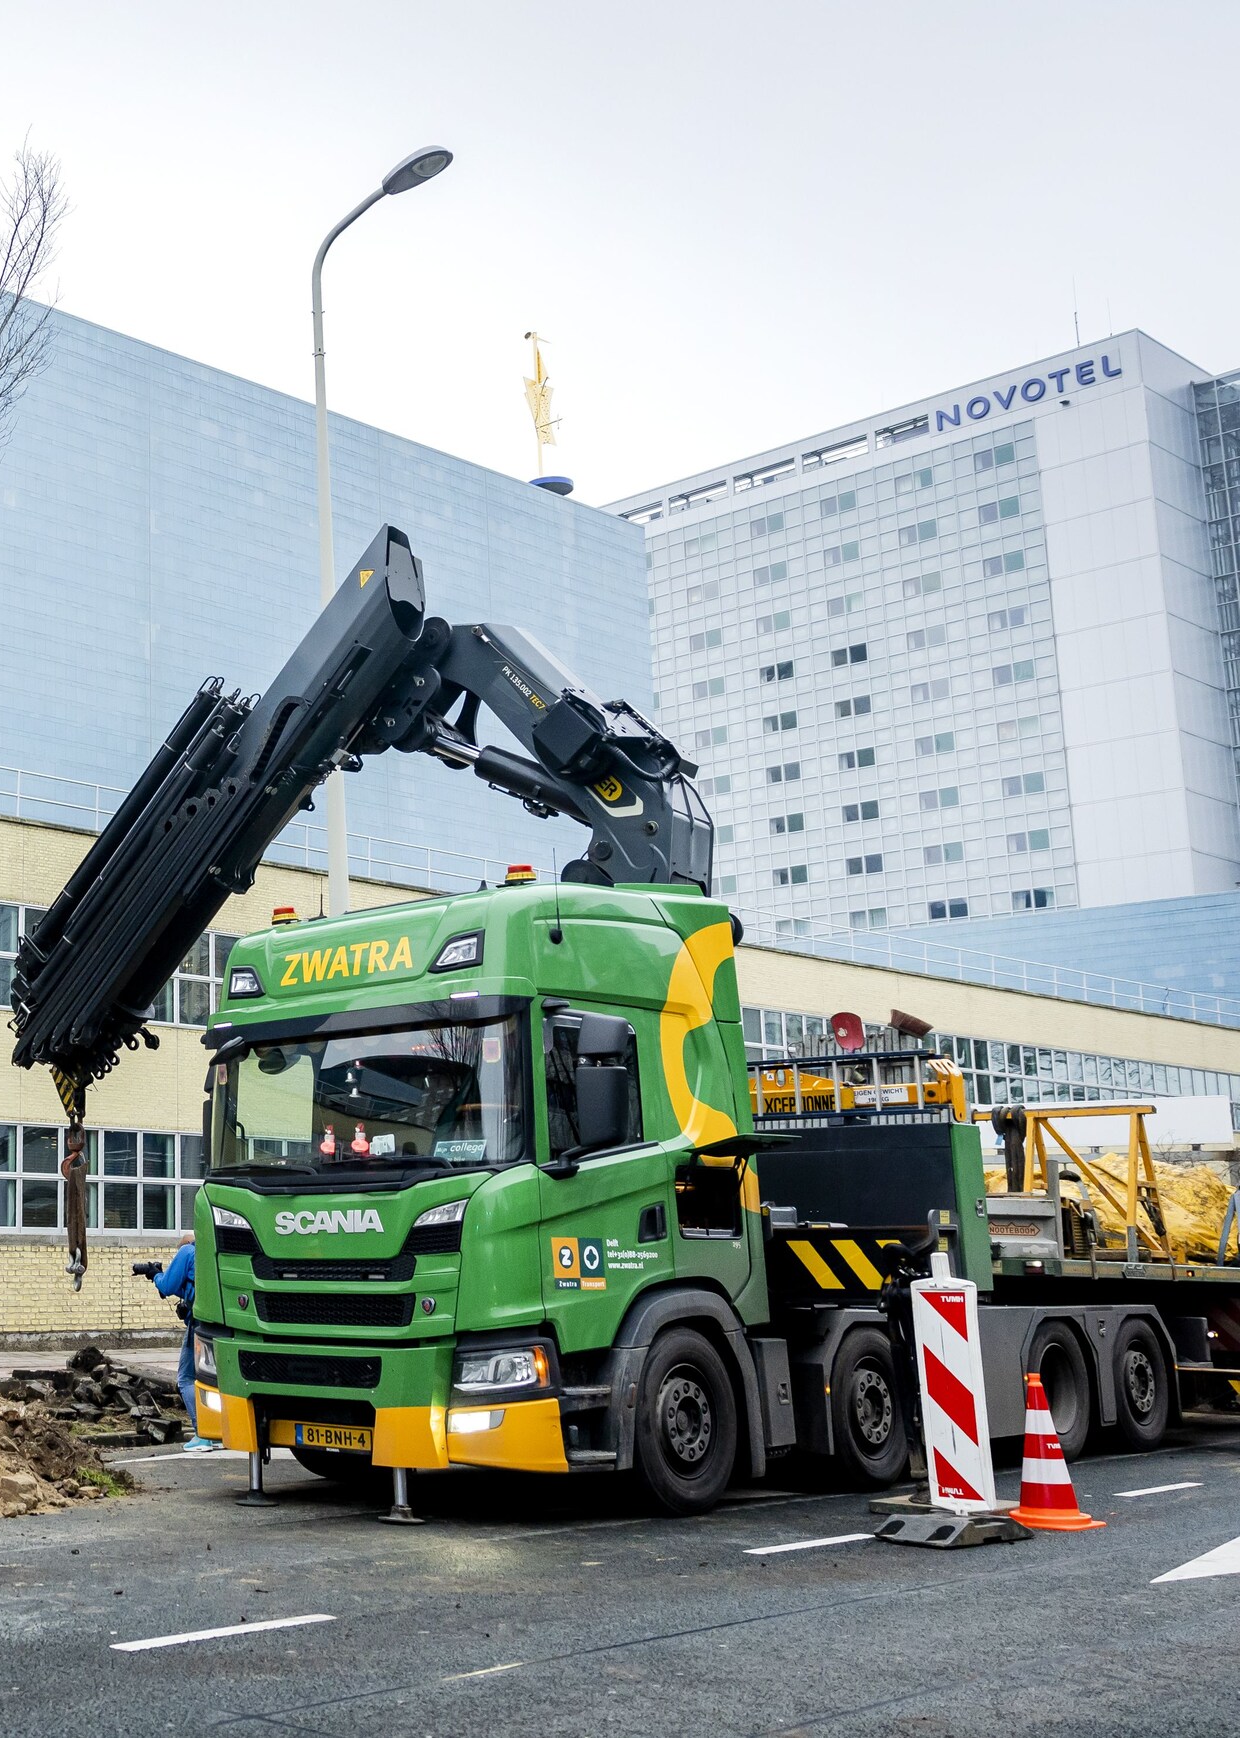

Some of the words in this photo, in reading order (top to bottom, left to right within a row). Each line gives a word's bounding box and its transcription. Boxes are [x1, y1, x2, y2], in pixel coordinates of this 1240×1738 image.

[936, 355, 1122, 431] NOVOTEL
[502, 665, 512, 677] PK
[510, 674, 532, 697] 135.002
[530, 694, 546, 710] TEC7
[280, 936, 413, 986] ZWATRA
[450, 1143, 484, 1153] collega
[275, 1209, 384, 1235] SCANIA
[989, 1226, 1036, 1234] NOOTEBOOM
[606, 1239, 619, 1247] Delft
[940, 1295, 964, 1303] TVMH
[307, 1428, 366, 1447] 81-BNH-4
